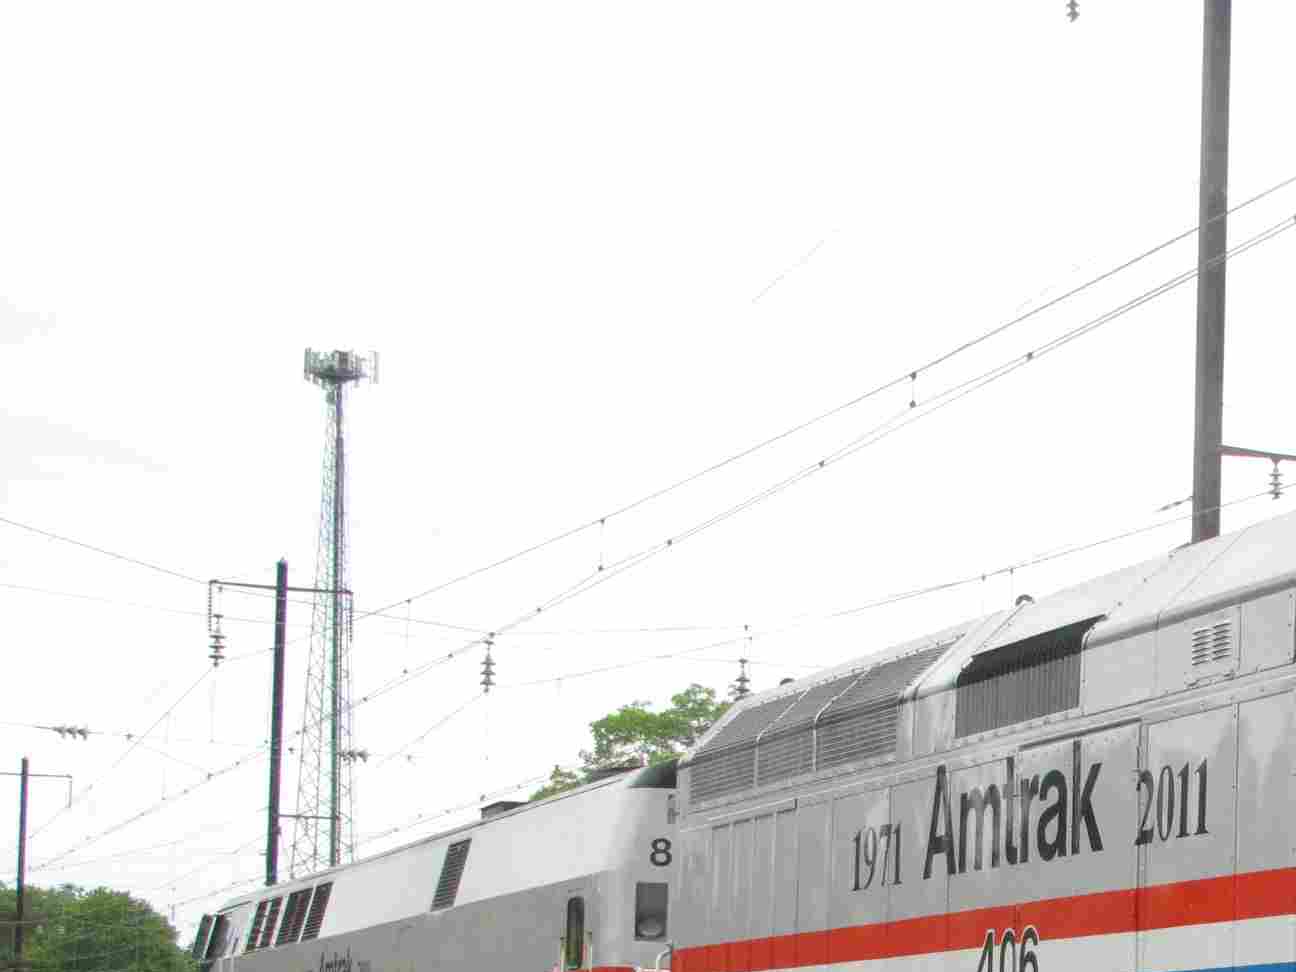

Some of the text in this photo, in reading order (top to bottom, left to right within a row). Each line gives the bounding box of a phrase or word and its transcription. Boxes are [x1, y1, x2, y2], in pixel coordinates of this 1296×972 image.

[649, 838, 672, 867] 8
[851, 744, 1210, 891] 1971 Amtrak 2011
